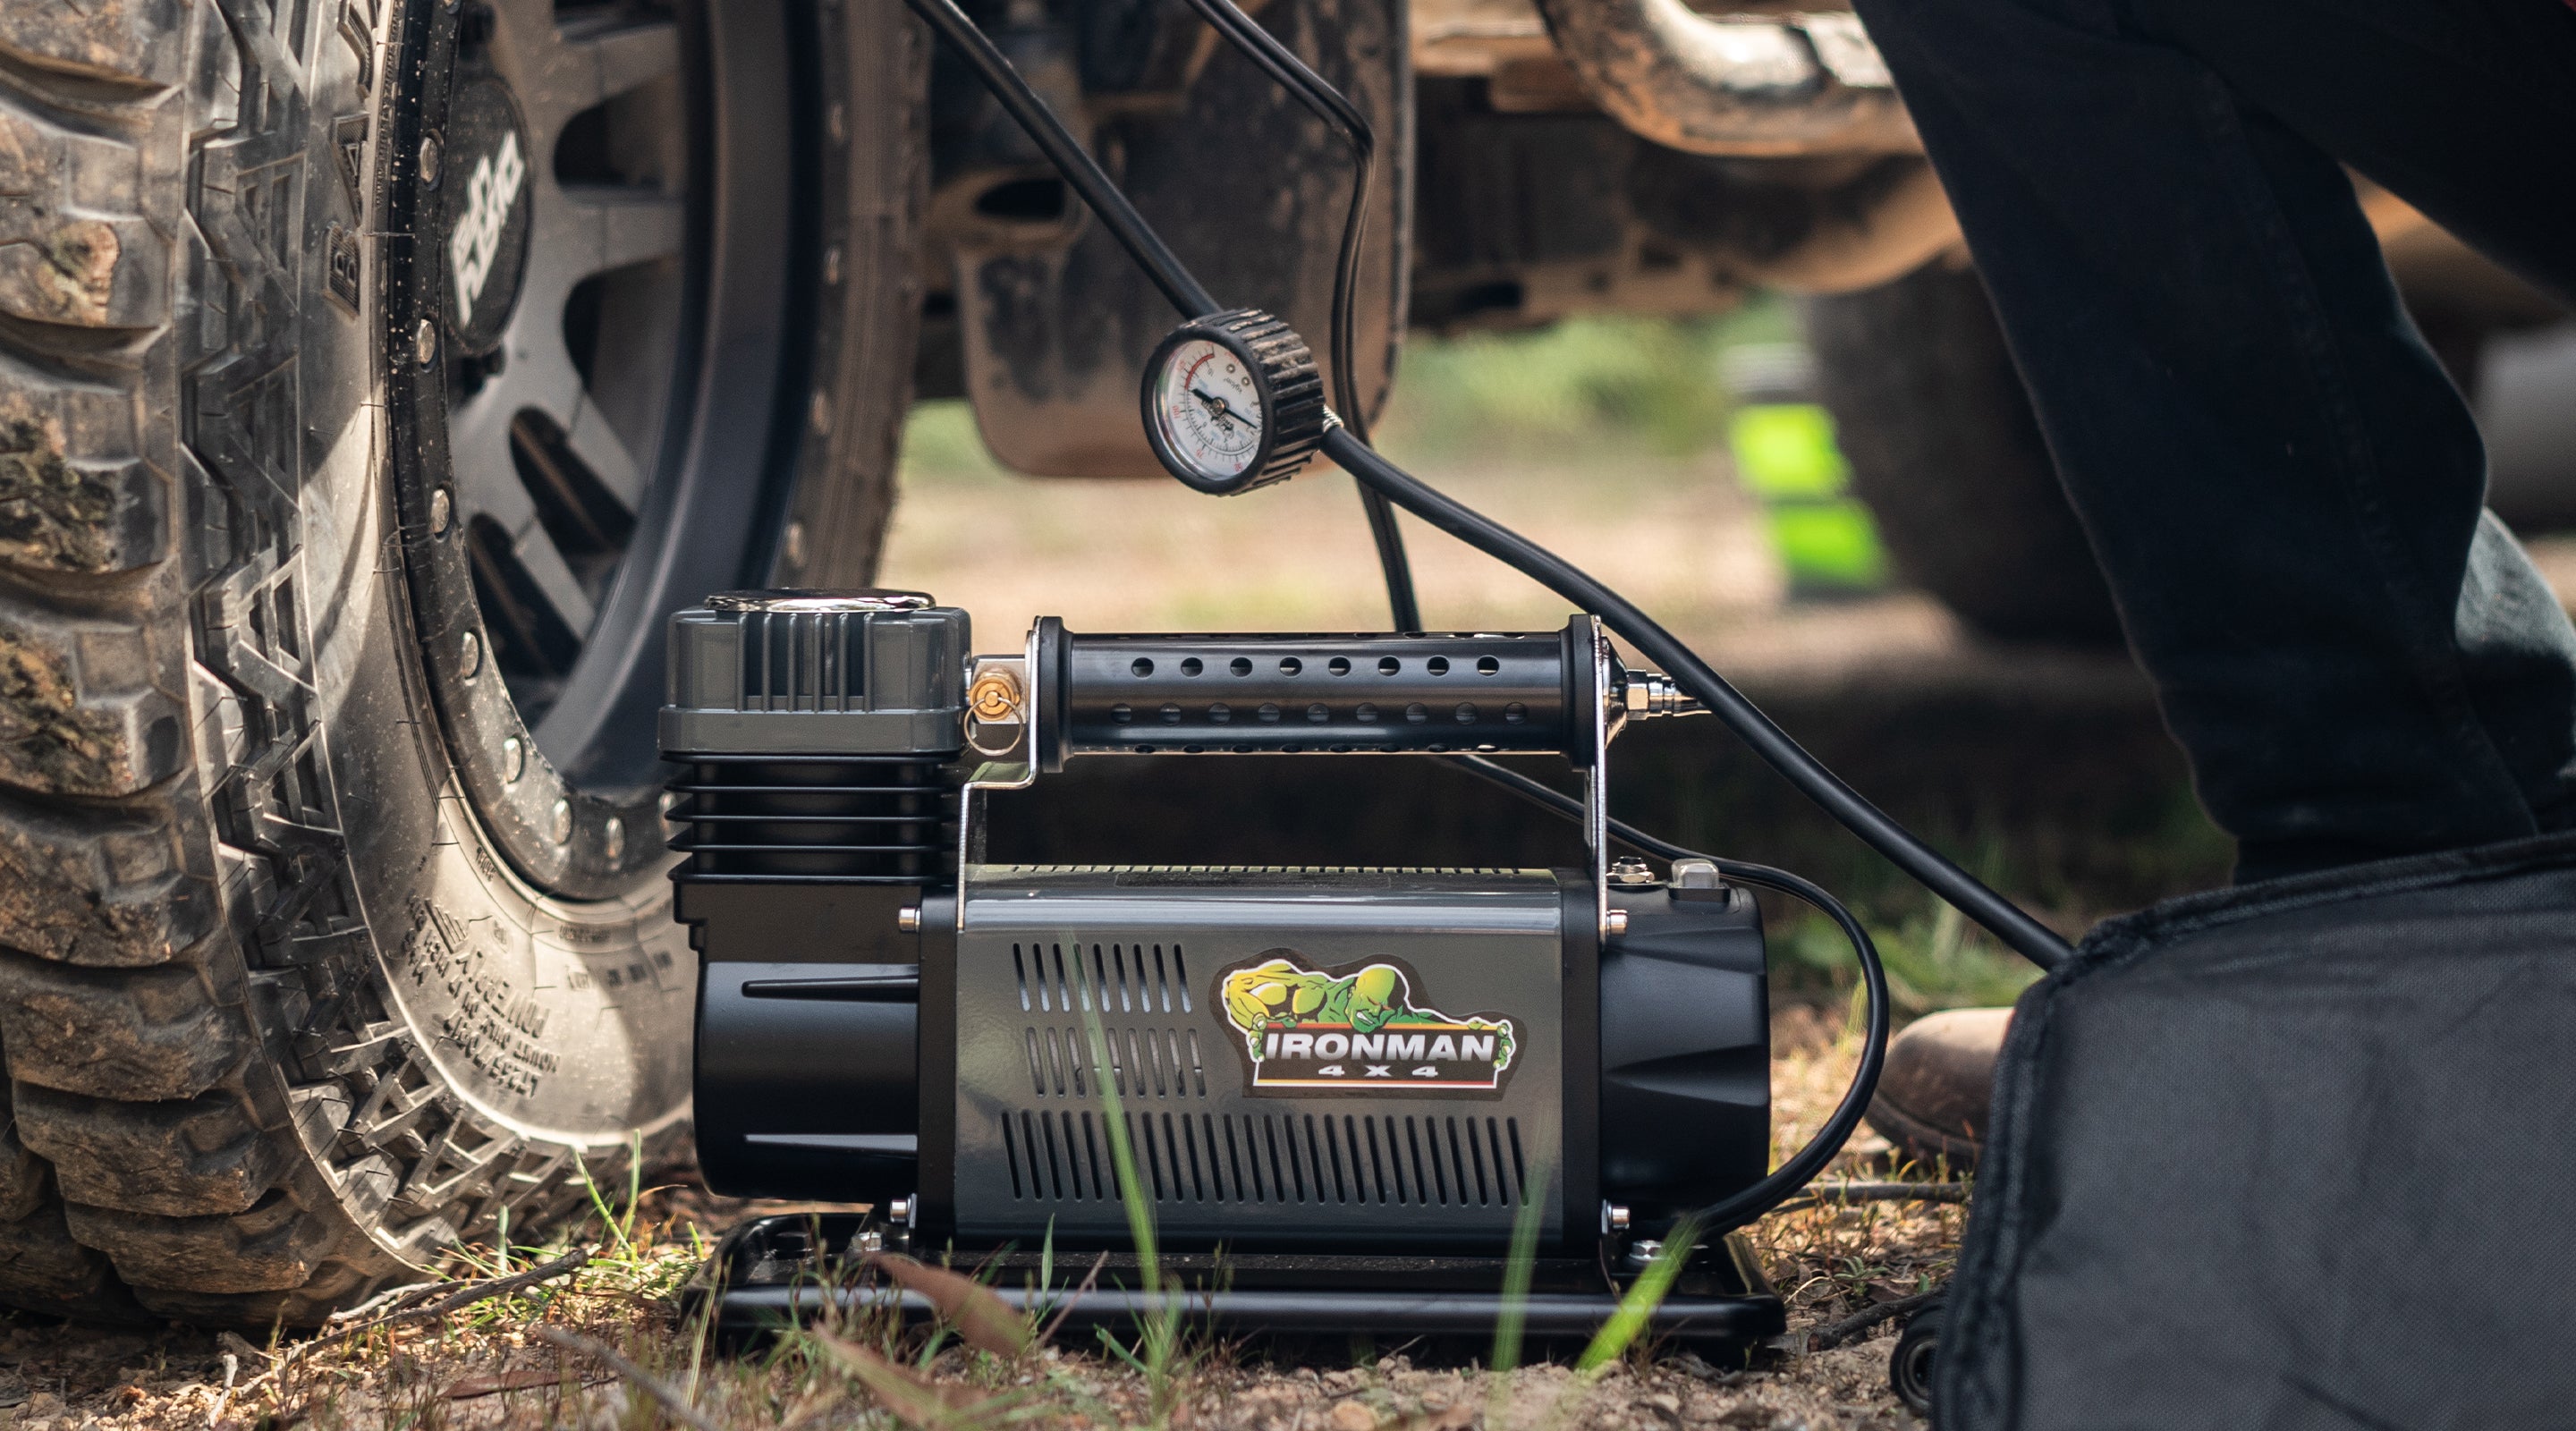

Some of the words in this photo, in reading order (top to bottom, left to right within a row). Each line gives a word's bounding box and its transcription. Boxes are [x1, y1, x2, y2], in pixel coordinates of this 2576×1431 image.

[322, 0, 381, 321] BAJ
[513, 1039, 561, 1073] MOUNT
[1266, 1033, 1495, 1062] IRONMAN
[1318, 1065, 1345, 1077] 4
[1411, 1066, 1438, 1078] 4
